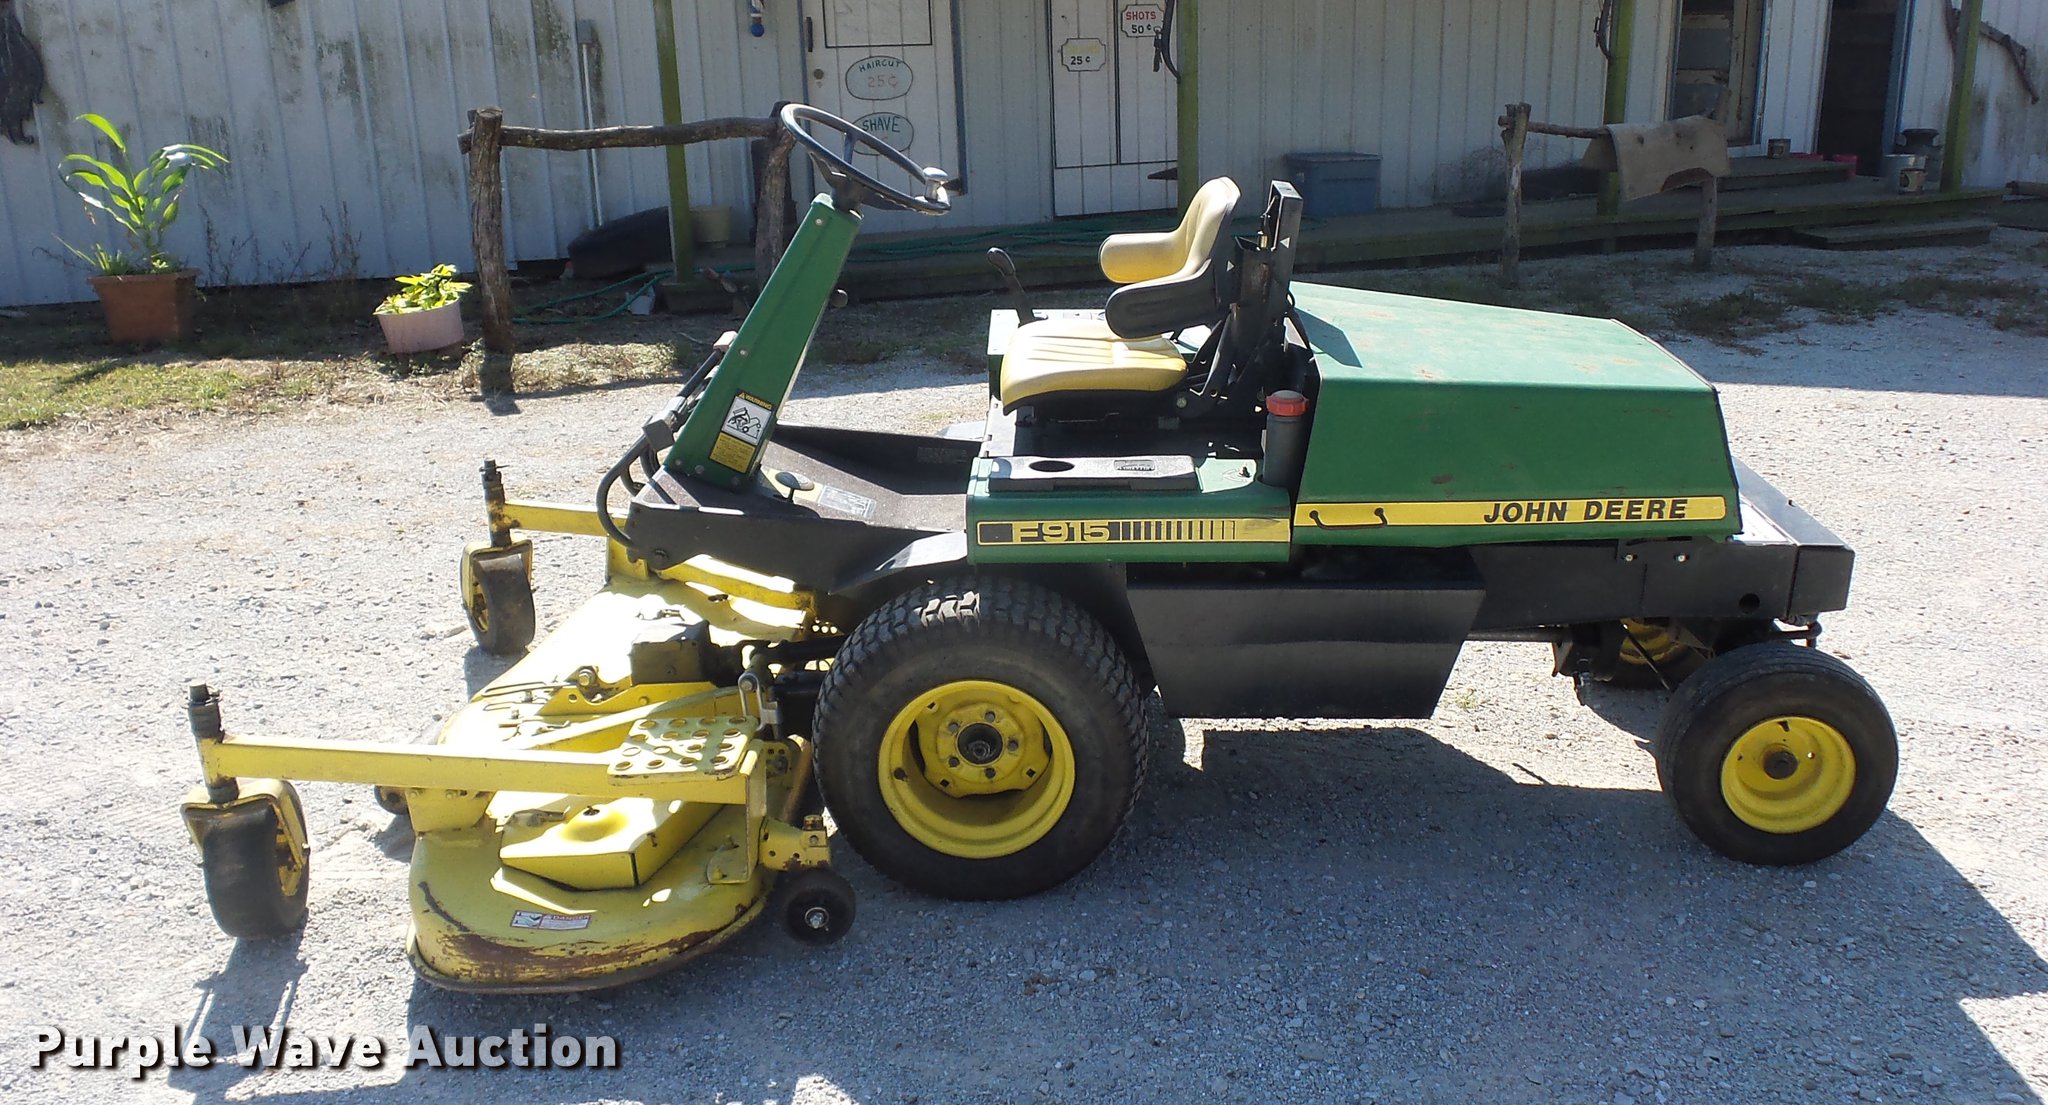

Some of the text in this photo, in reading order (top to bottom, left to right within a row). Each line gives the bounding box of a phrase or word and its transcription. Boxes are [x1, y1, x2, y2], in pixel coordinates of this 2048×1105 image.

[1126, 11, 1157, 21] SHOTS
[859, 59, 902, 73] HAIRCUT
[862, 115, 901, 133] SHAVE
[1483, 499, 1688, 523] JOHN DEERE
[1012, 521, 1111, 543] F915
